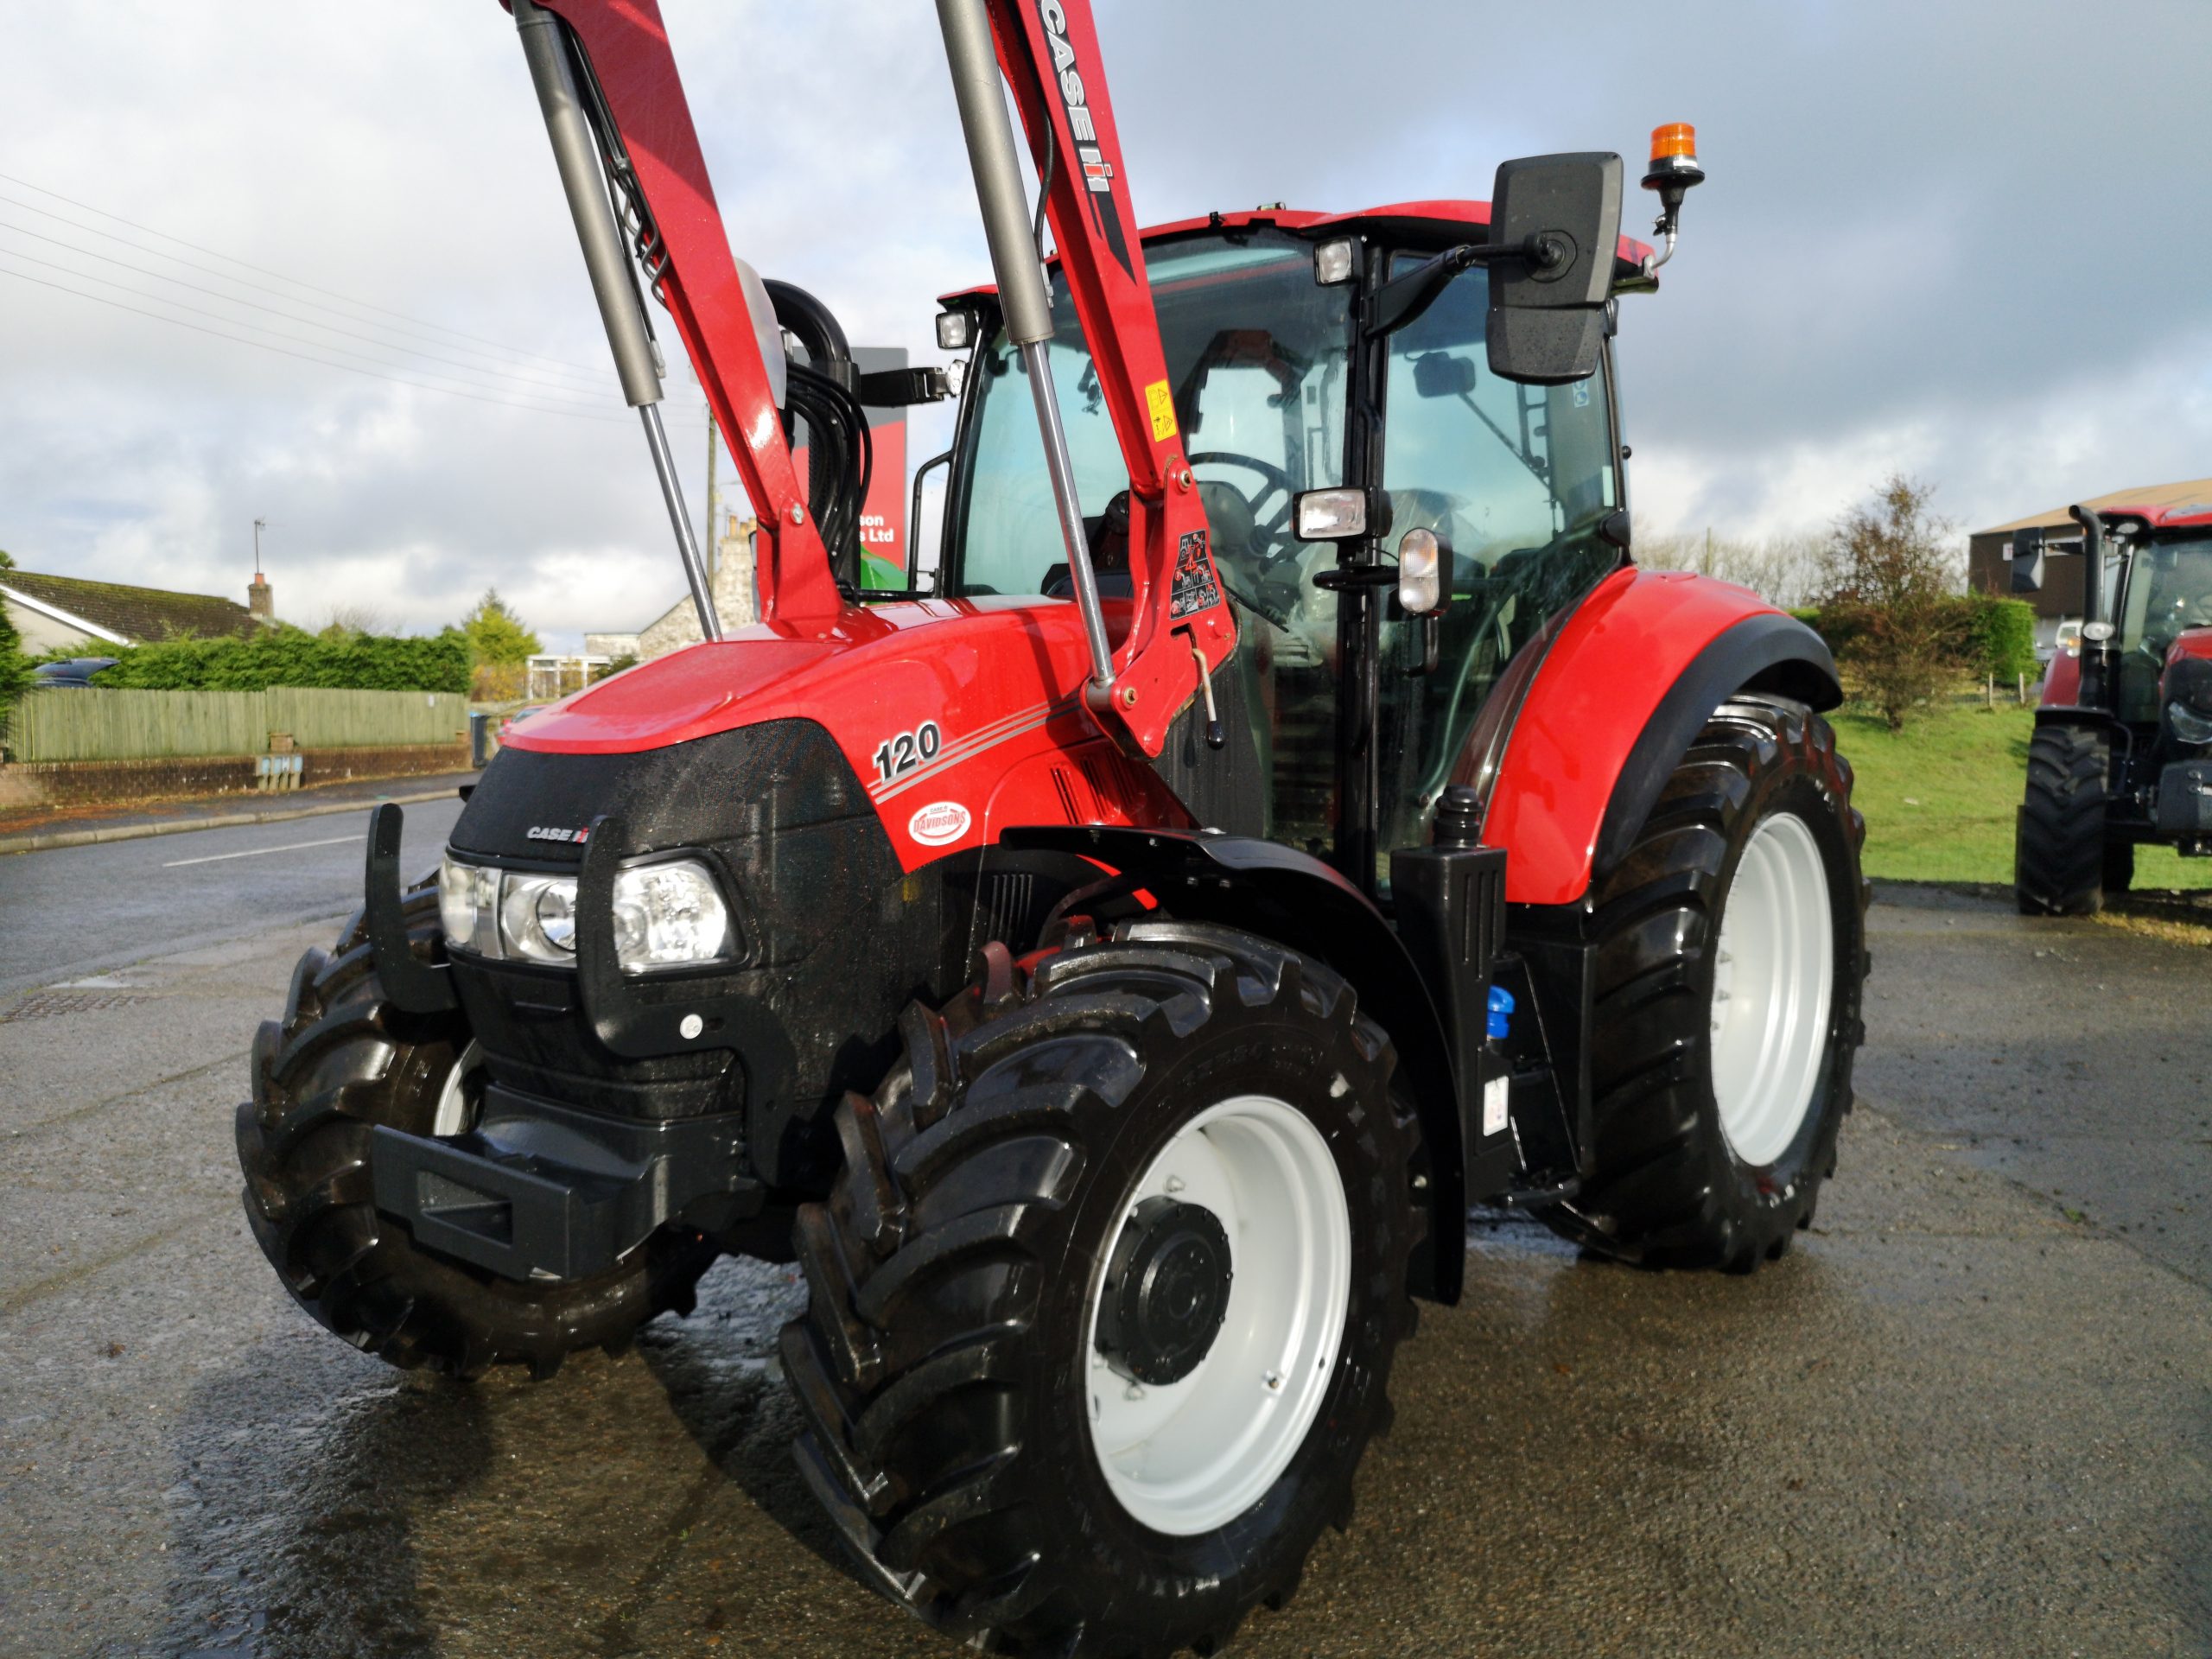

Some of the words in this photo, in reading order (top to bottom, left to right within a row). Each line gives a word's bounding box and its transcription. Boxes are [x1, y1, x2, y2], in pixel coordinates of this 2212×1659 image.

[1040, 0, 1096, 141] CASE
[868, 528, 894, 543] Ltd
[872, 720, 941, 782] 120
[527, 827, 572, 841] CASE
